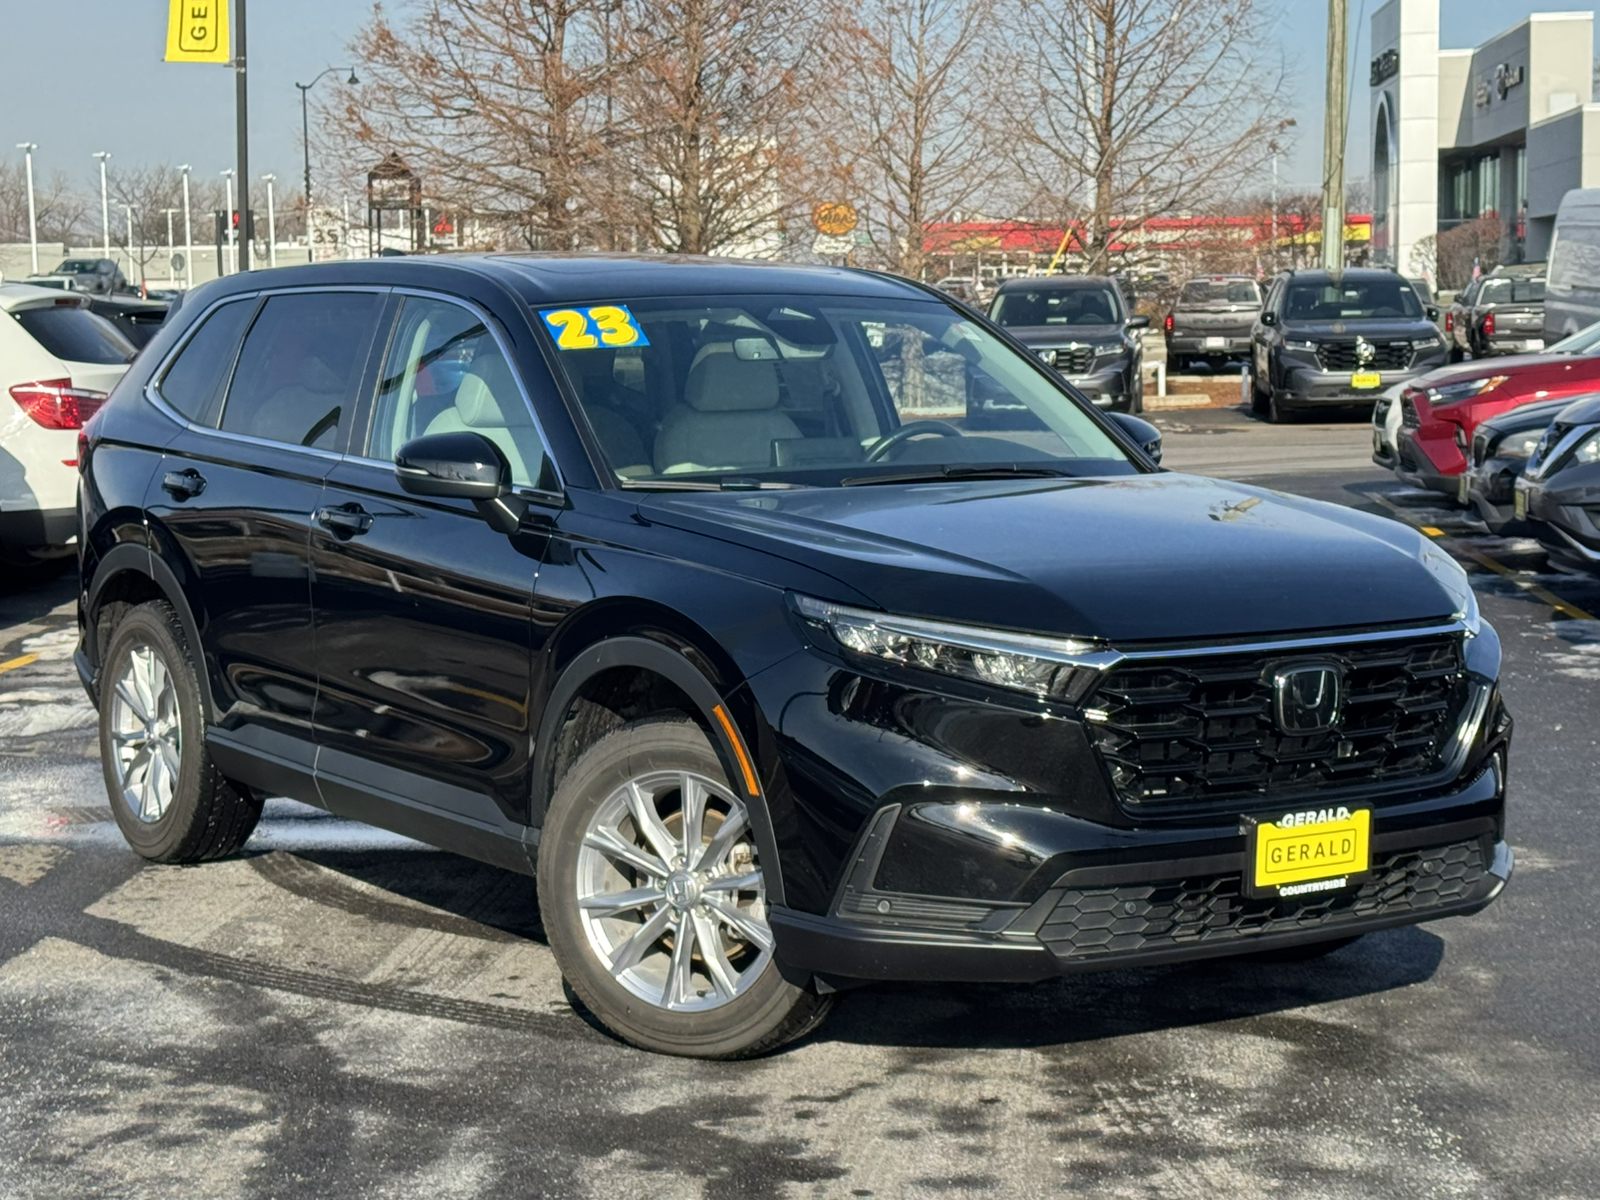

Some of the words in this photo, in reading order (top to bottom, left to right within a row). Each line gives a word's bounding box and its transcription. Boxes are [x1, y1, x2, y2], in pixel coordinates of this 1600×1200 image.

[312, 228, 339, 244] 35
[545, 305, 639, 349] 23
[1281, 806, 1349, 828] GERALD
[1271, 838, 1351, 864] GERALD
[1279, 877, 1347, 897] COUNTRYSIDE
